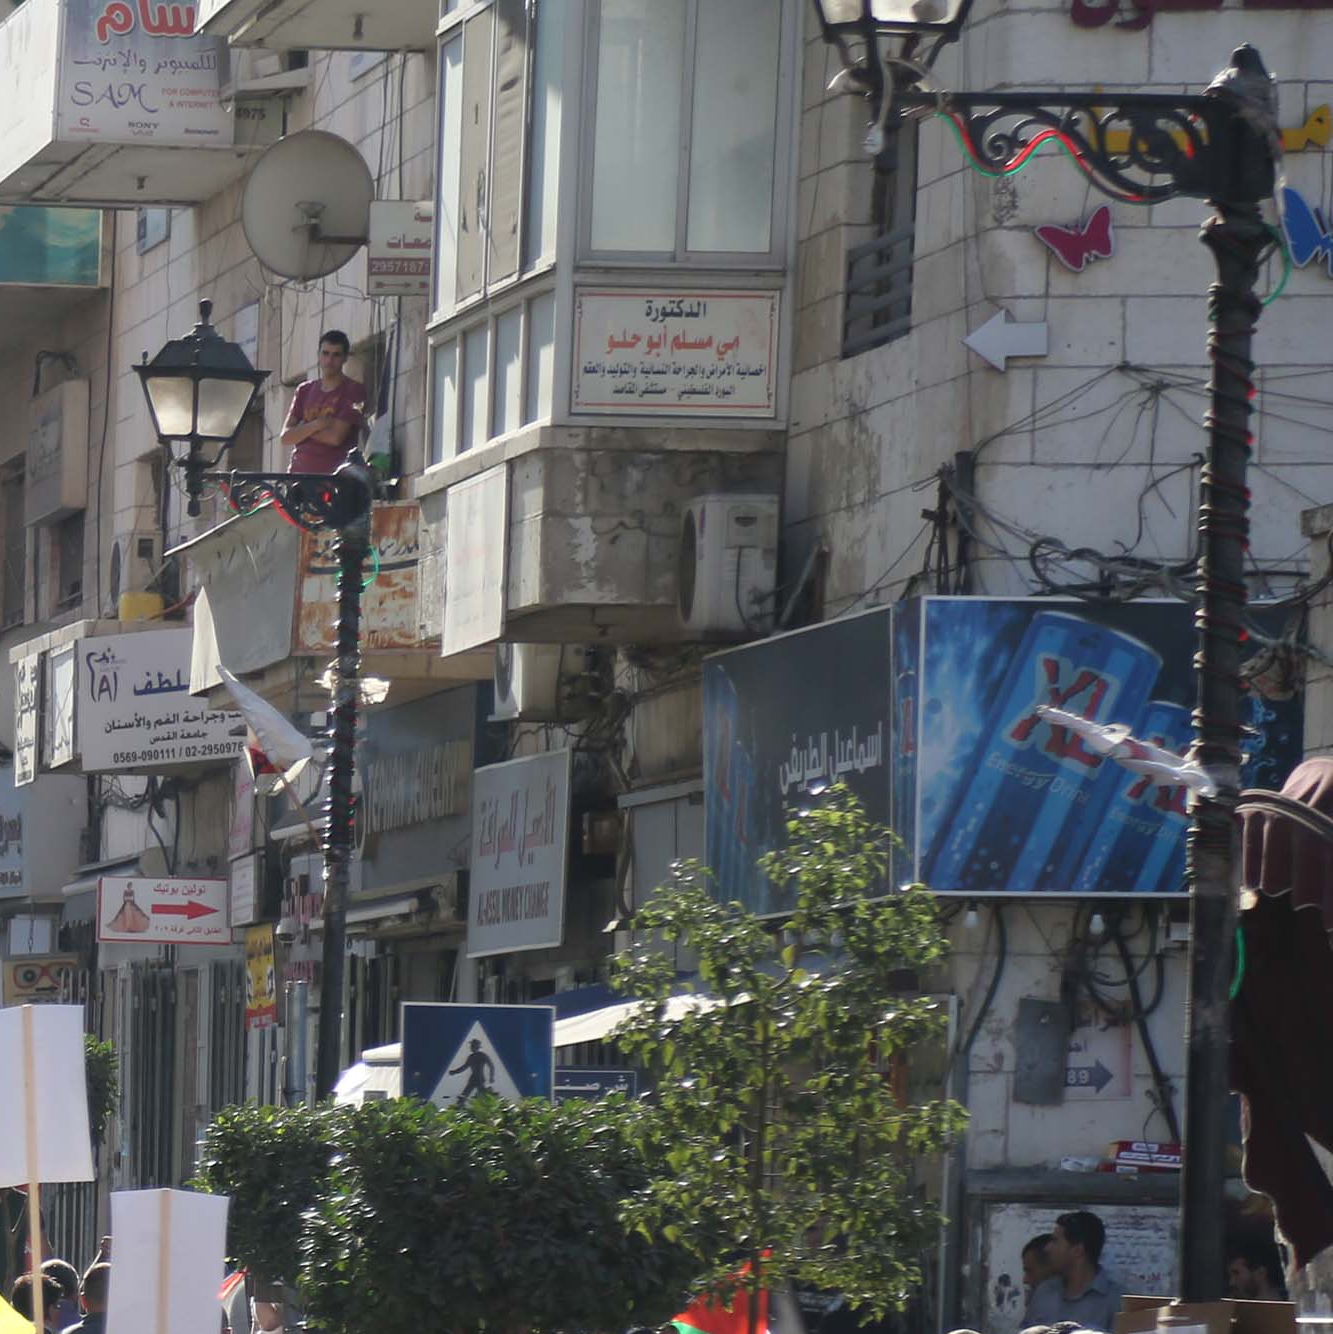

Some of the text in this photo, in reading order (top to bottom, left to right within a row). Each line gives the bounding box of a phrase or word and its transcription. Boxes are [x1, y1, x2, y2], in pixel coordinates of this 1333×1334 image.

[71, 81, 158, 113] SAM
[645, 298, 706, 322] الدكتورة
[605, 325, 740, 360] مي مسلم أبو حلو
[677, 385, 713, 401] الفلسطيني
[104, 710, 225, 734] وجراحة الفم والأسنان
[149, 730, 208, 745] جامعة القدس
[987, 750, 1049, 792] Energy
[501, 885, 522, 924] MONEY
